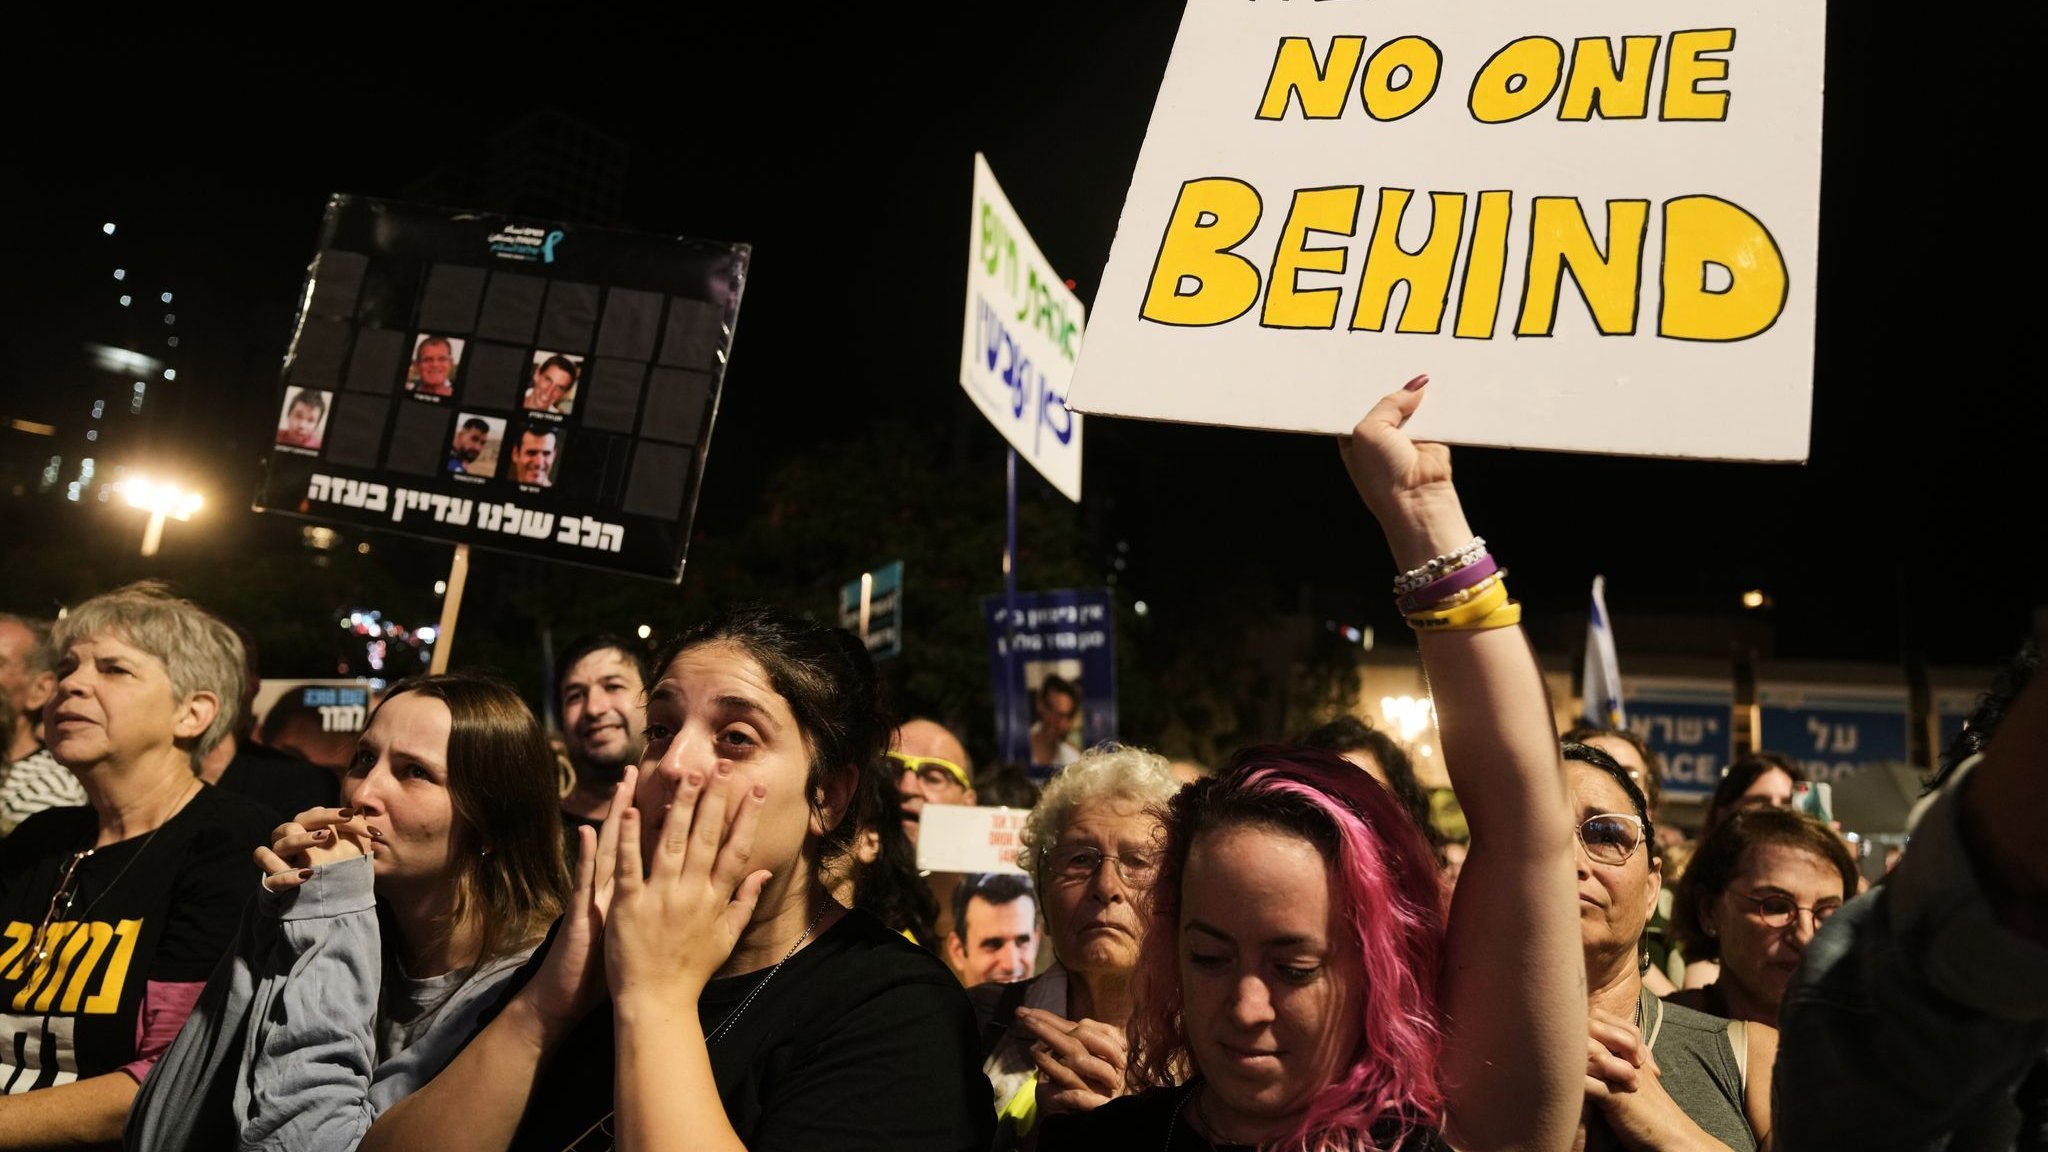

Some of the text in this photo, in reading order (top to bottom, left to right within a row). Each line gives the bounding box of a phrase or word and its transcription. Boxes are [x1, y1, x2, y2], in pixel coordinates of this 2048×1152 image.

[1256, 27, 1736, 124] NO ONE
[1138, 176, 1790, 343] BEHIND
[307, 472, 625, 553] הלב שלנו עדיין בעזה
[1628, 713, 1720, 746] ישרא
[1806, 715, 1858, 753] על
[1655, 752, 1717, 784] ACE
